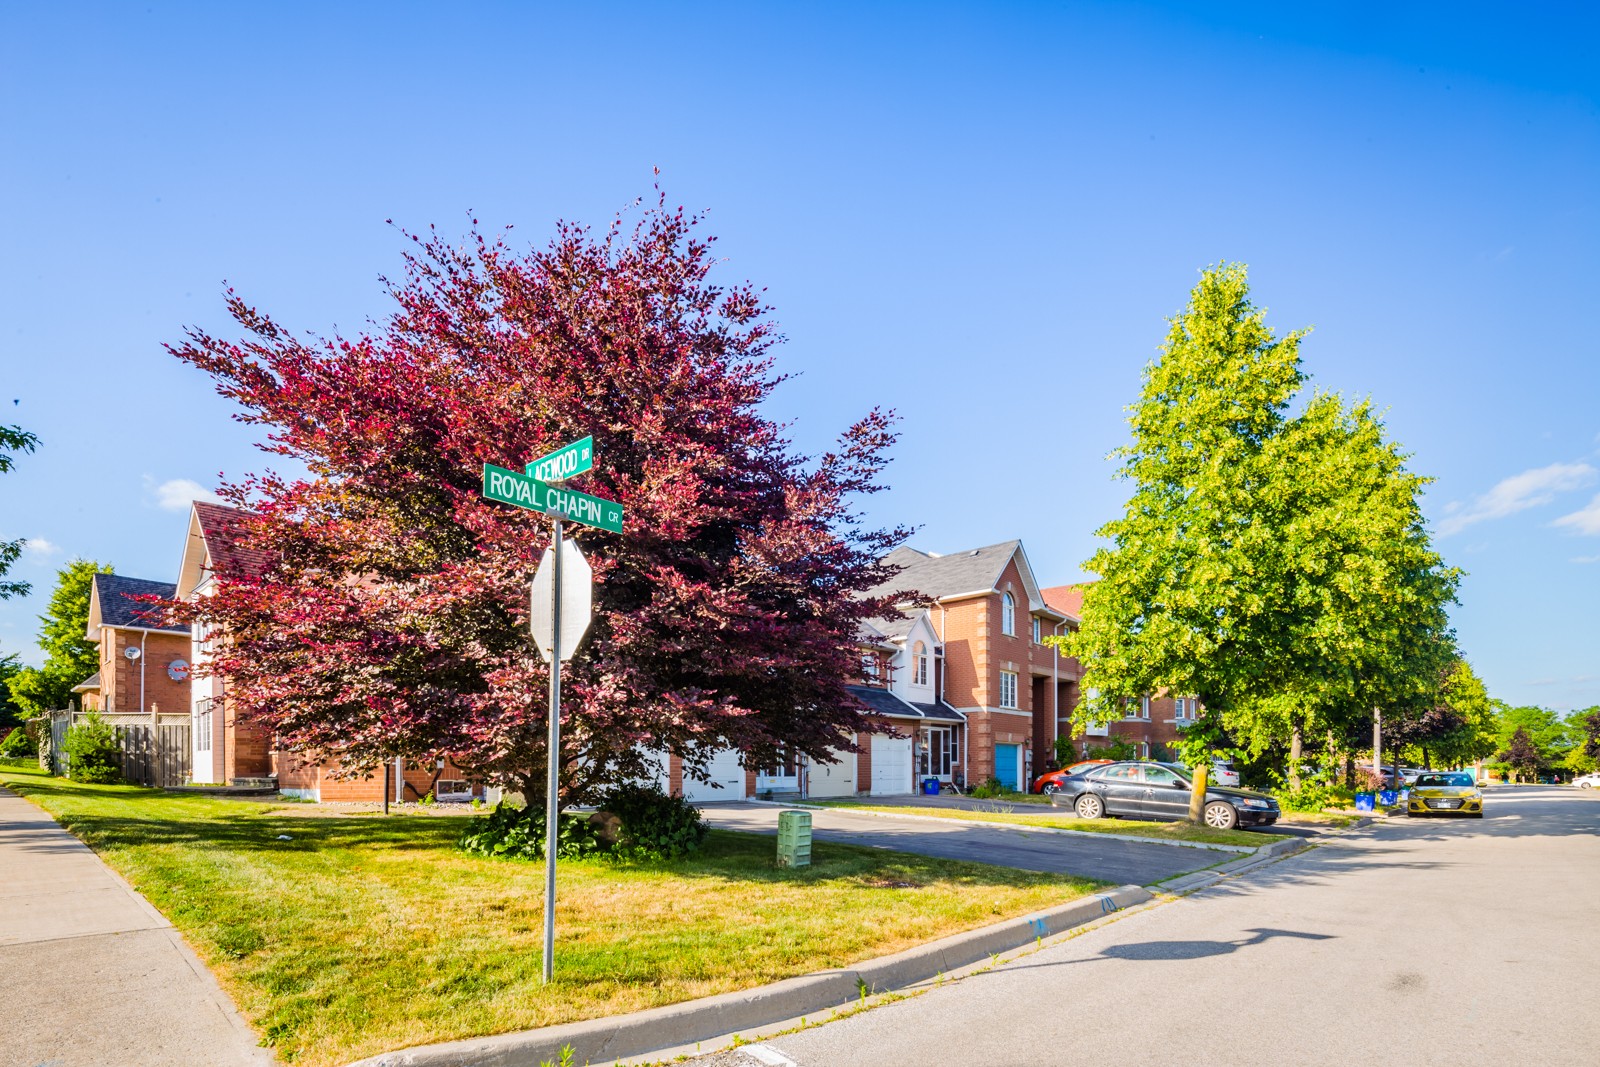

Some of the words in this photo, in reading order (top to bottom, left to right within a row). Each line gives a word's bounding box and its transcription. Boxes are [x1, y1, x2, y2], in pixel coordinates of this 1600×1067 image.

[582, 447, 590, 461] DR
[490, 471, 543, 507] ROYAL
[546, 488, 602, 523] CHAPIN
[608, 511, 619, 524] CR
